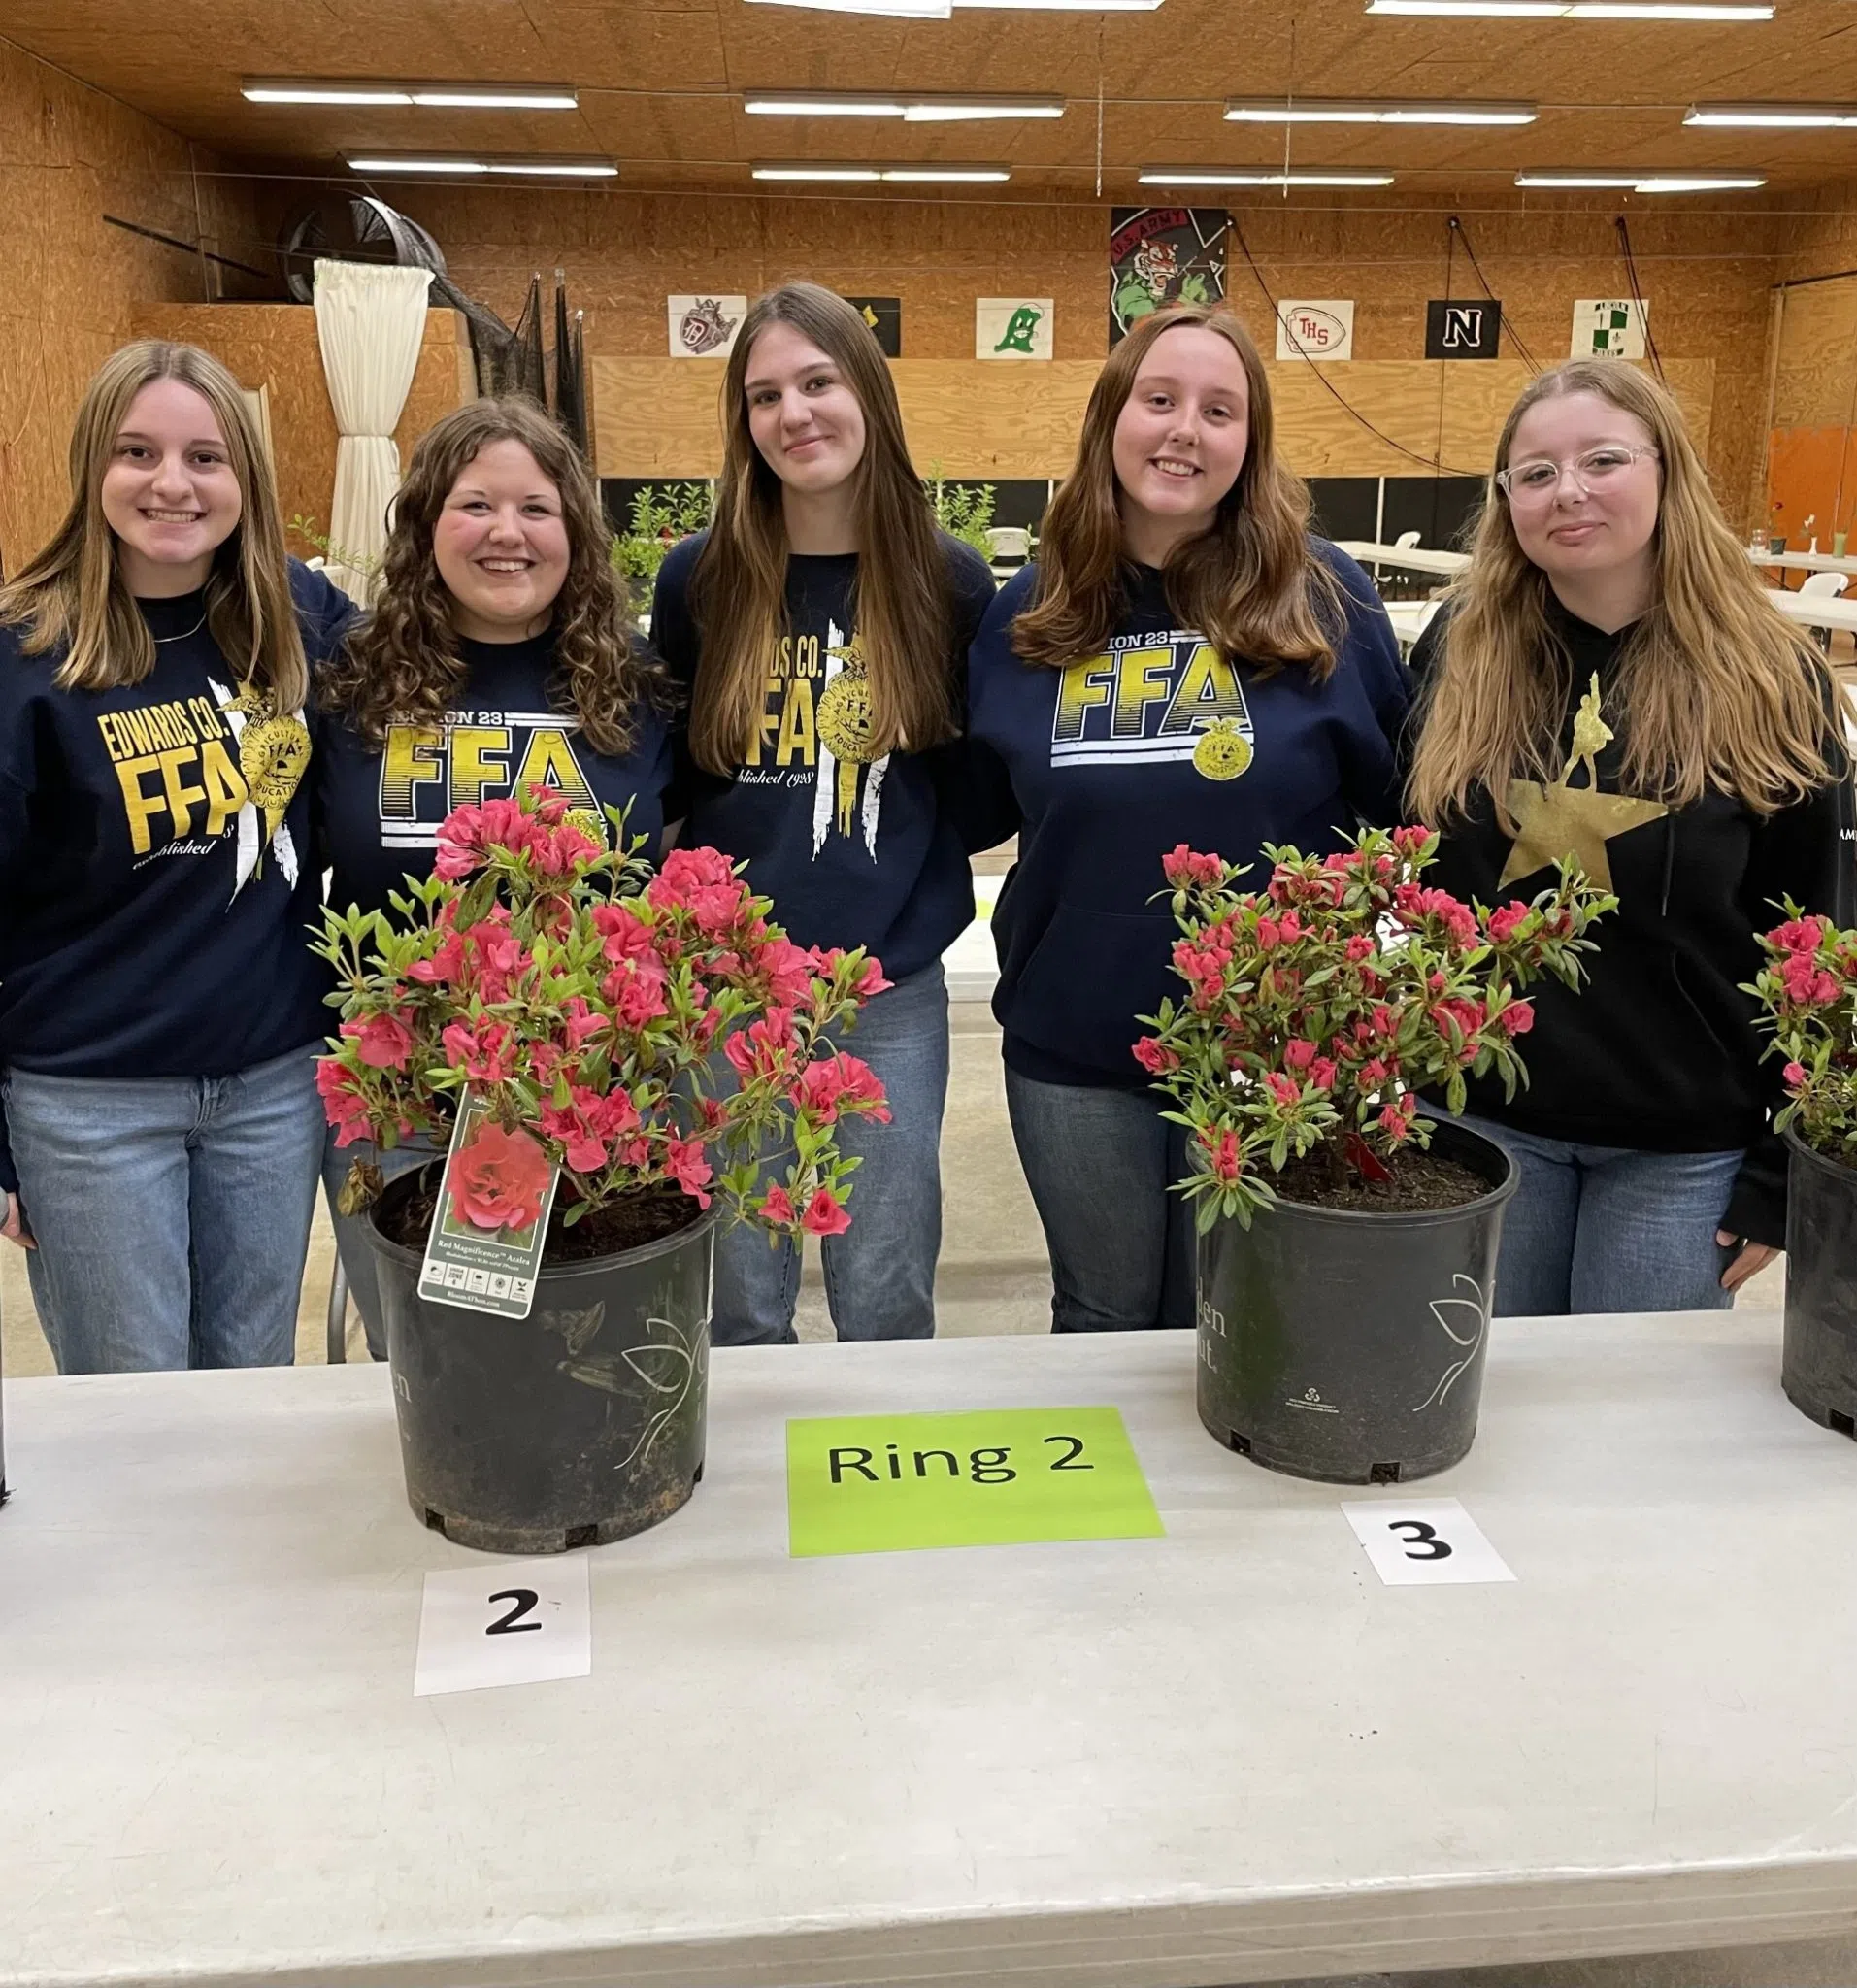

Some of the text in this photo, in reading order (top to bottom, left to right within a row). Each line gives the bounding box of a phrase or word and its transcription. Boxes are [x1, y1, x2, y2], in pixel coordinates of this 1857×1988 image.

[1139, 211, 1181, 234] ARMY
[1300, 318, 1329, 345] THS
[1442, 309, 1482, 347] N
[1145, 631, 1169, 646] 23
[847, 699, 873, 717] FF
[1052, 642, 1254, 743] FFA
[98, 695, 231, 762] EDWARDS CO.
[478, 711, 503, 725] 23
[746, 678, 816, 766] FA
[269, 742, 296, 758] FFA
[379, 724, 607, 824] FFA
[787, 771, 814, 788] 1928
[115, 740, 249, 855] FFA
[438, 1239, 452, 1249] Red
[507, 1254, 531, 1266] Azalea
[828, 1435, 1095, 1484] Ring 2
[1387, 1519, 1453, 1561] 3
[485, 1588, 543, 1636] 2
